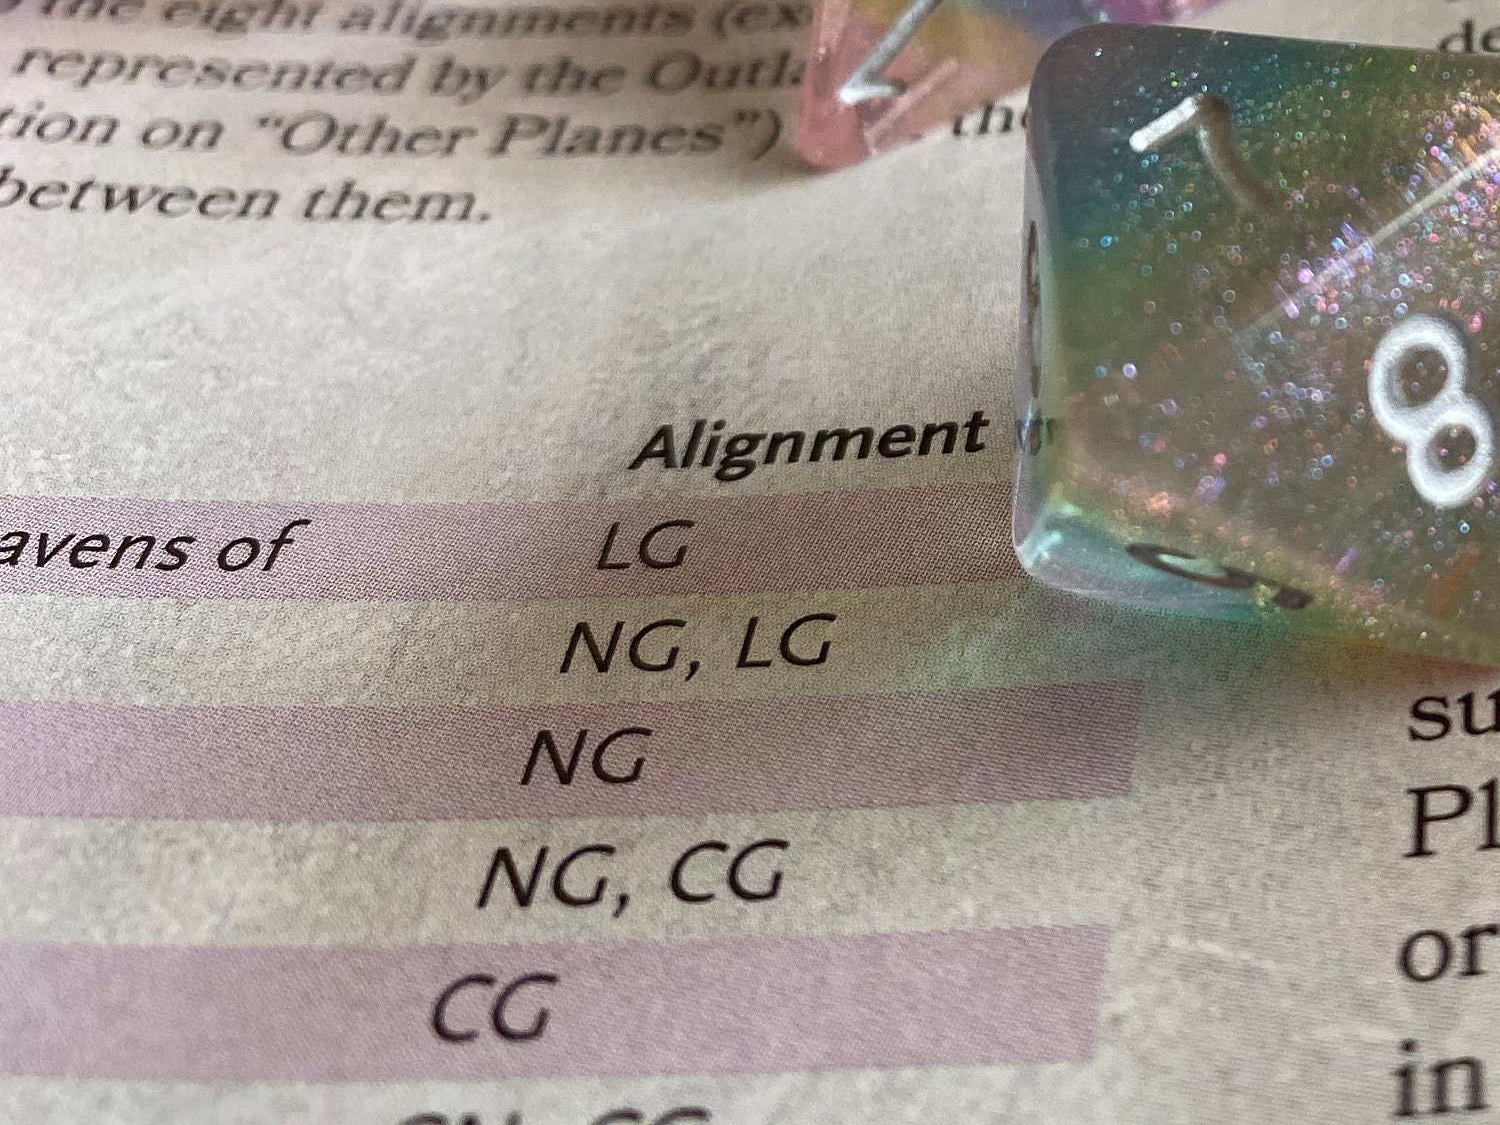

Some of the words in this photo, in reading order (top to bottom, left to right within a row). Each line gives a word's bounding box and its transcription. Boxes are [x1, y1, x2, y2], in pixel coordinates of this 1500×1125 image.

[14, 45, 420, 96] represented
[428, 51, 505, 106] by
[523, 51, 630, 96] the
[643, 47, 806, 96] Outl
[0, 98, 121, 149] tion
[140, 115, 226, 153] on
[302, 175, 492, 222] them.
[628, 409, 991, 483] Alignment
[1367, 312, 1497, 512] 8
[0, 529, 198, 572] avens
[216, 518, 313, 573] of
[596, 518, 696, 572] LG
[558, 616, 703, 682] NG,
[735, 612, 838, 671] LG
[520, 725, 654, 788] NG
[475, 843, 633, 921] NG,
[669, 837, 792, 904] CG
[430, 972, 561, 1046] CG
[1391, 1036, 1490, 1118] in
